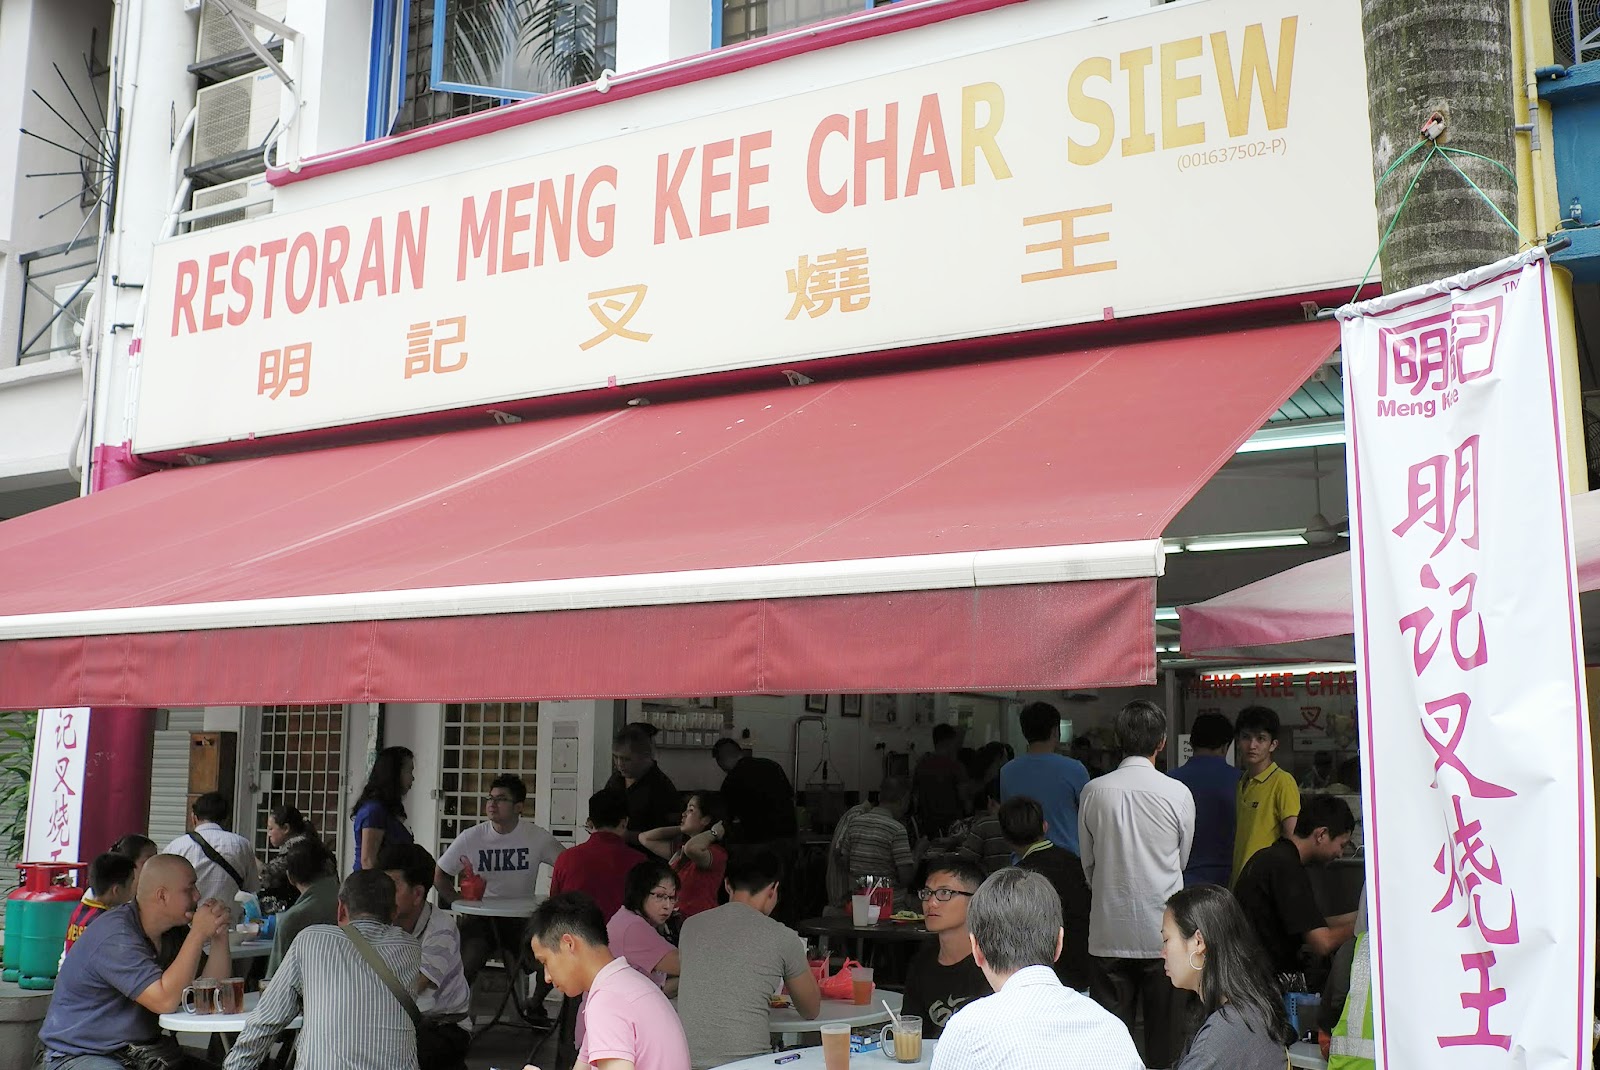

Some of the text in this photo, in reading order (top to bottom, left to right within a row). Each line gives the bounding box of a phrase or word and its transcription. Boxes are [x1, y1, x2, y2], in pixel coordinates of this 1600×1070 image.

[1177, 137, 1287, 172] (001637502-P)
[172, 16, 1297, 336] RESTORAN MENG KEE CHAR SIEW
[1377, 399, 1436, 418] Meng
[1256, 672, 1295, 698] KEE
[1305, 671, 1357, 697] CHA
[1391, 434, 1517, 1050] 明记叉烧王
[478, 848, 529, 871] NIKE
